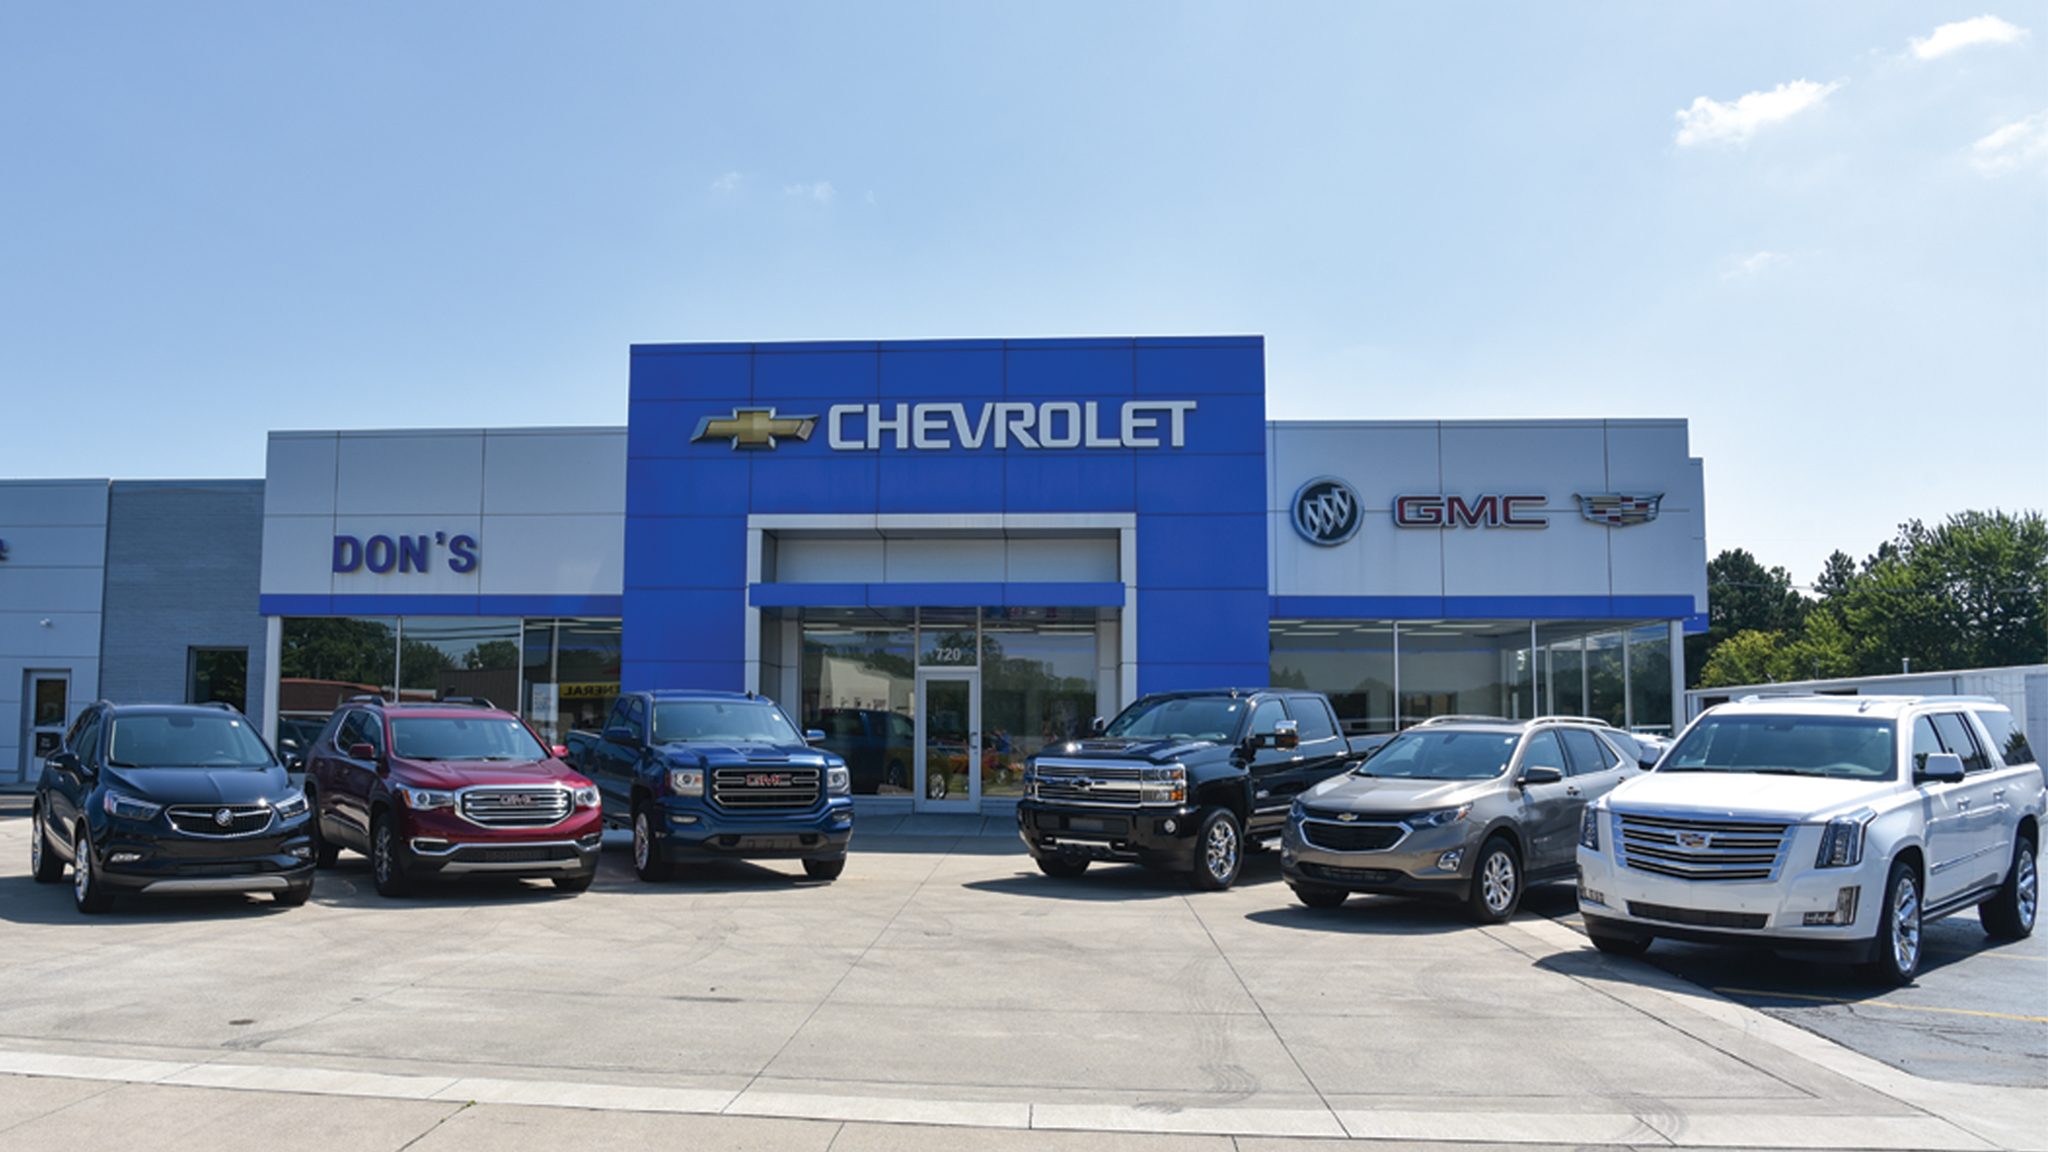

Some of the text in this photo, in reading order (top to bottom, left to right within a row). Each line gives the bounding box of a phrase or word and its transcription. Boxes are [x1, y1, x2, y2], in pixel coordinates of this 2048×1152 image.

[828, 401, 1197, 449] CHEVROLET
[1394, 494, 1549, 528] GMC
[332, 531, 477, 574] DON'S
[936, 648, 961, 661] 720
[746, 774, 792, 786] GMC
[500, 794, 540, 805] GMC
